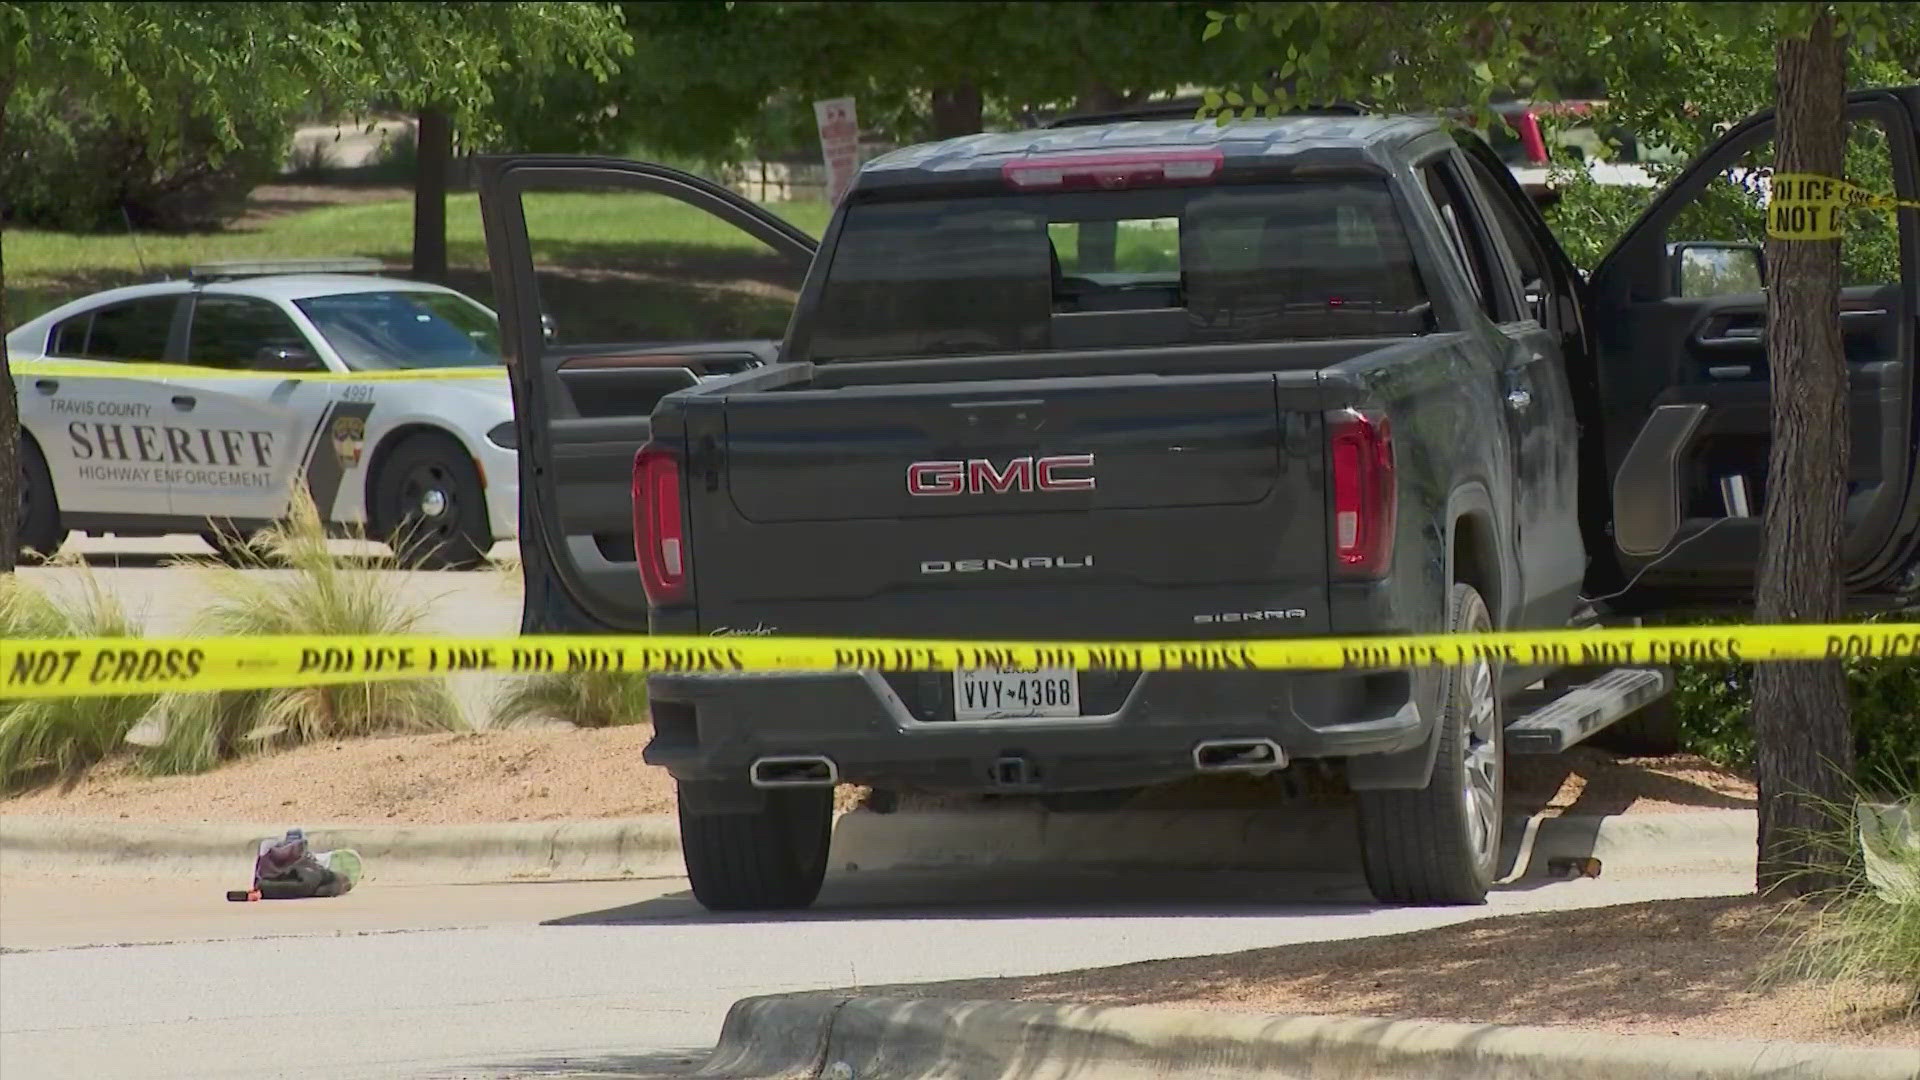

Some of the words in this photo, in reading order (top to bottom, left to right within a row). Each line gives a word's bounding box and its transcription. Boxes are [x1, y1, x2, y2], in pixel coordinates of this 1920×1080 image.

[1776, 205, 1822, 232] NOT
[342, 385, 375, 401] 4991
[50, 399, 94, 416] TRAVIS
[97, 402, 151, 419] COUNTY
[68, 420, 275, 469] SHERIFF
[79, 465, 151, 482] HIGHWAY
[154, 467, 272, 488] ENFORCEMENT
[907, 453, 1096, 496] GMC
[920, 555, 1094, 574] DENALI
[1193, 608, 1307, 624] SIERRA
[8, 651, 81, 687] NOT
[89, 649, 204, 683] CROSS
